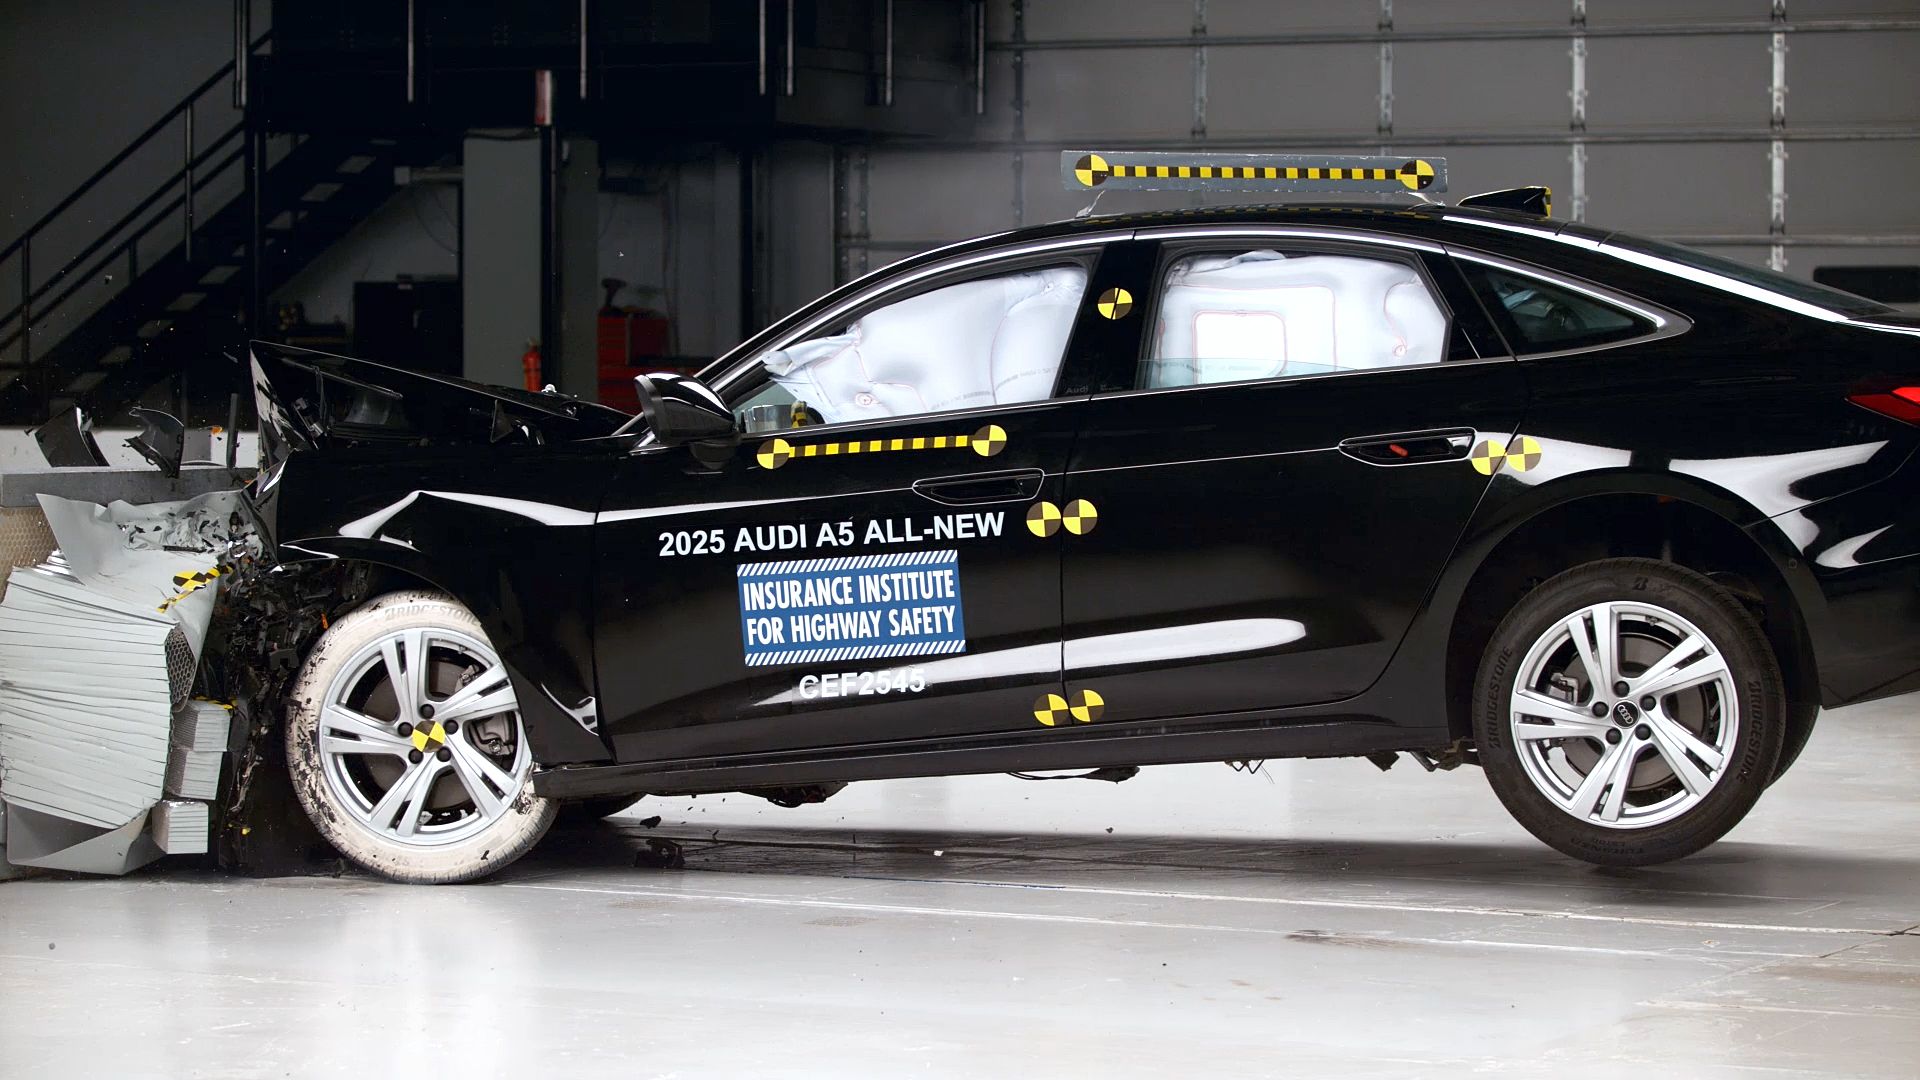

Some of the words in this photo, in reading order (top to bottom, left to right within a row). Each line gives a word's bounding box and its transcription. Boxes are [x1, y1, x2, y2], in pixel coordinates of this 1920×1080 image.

[659, 529, 725, 556] 2025
[734, 525, 806, 551] AUDI
[815, 521, 855, 547] A5
[864, 512, 1005, 544] ALL-NEW
[743, 577, 853, 611] INSURANCE
[859, 569, 955, 601] INSTITUTE
[746, 616, 785, 645] FOR
[791, 611, 881, 643] HIGHWAY
[889, 605, 955, 636] SAFETY
[799, 669, 926, 699] CEF2545
[1486, 646, 1513, 749] BRIDGESTONE
[1736, 680, 1763, 784] BRIDGESTONE
